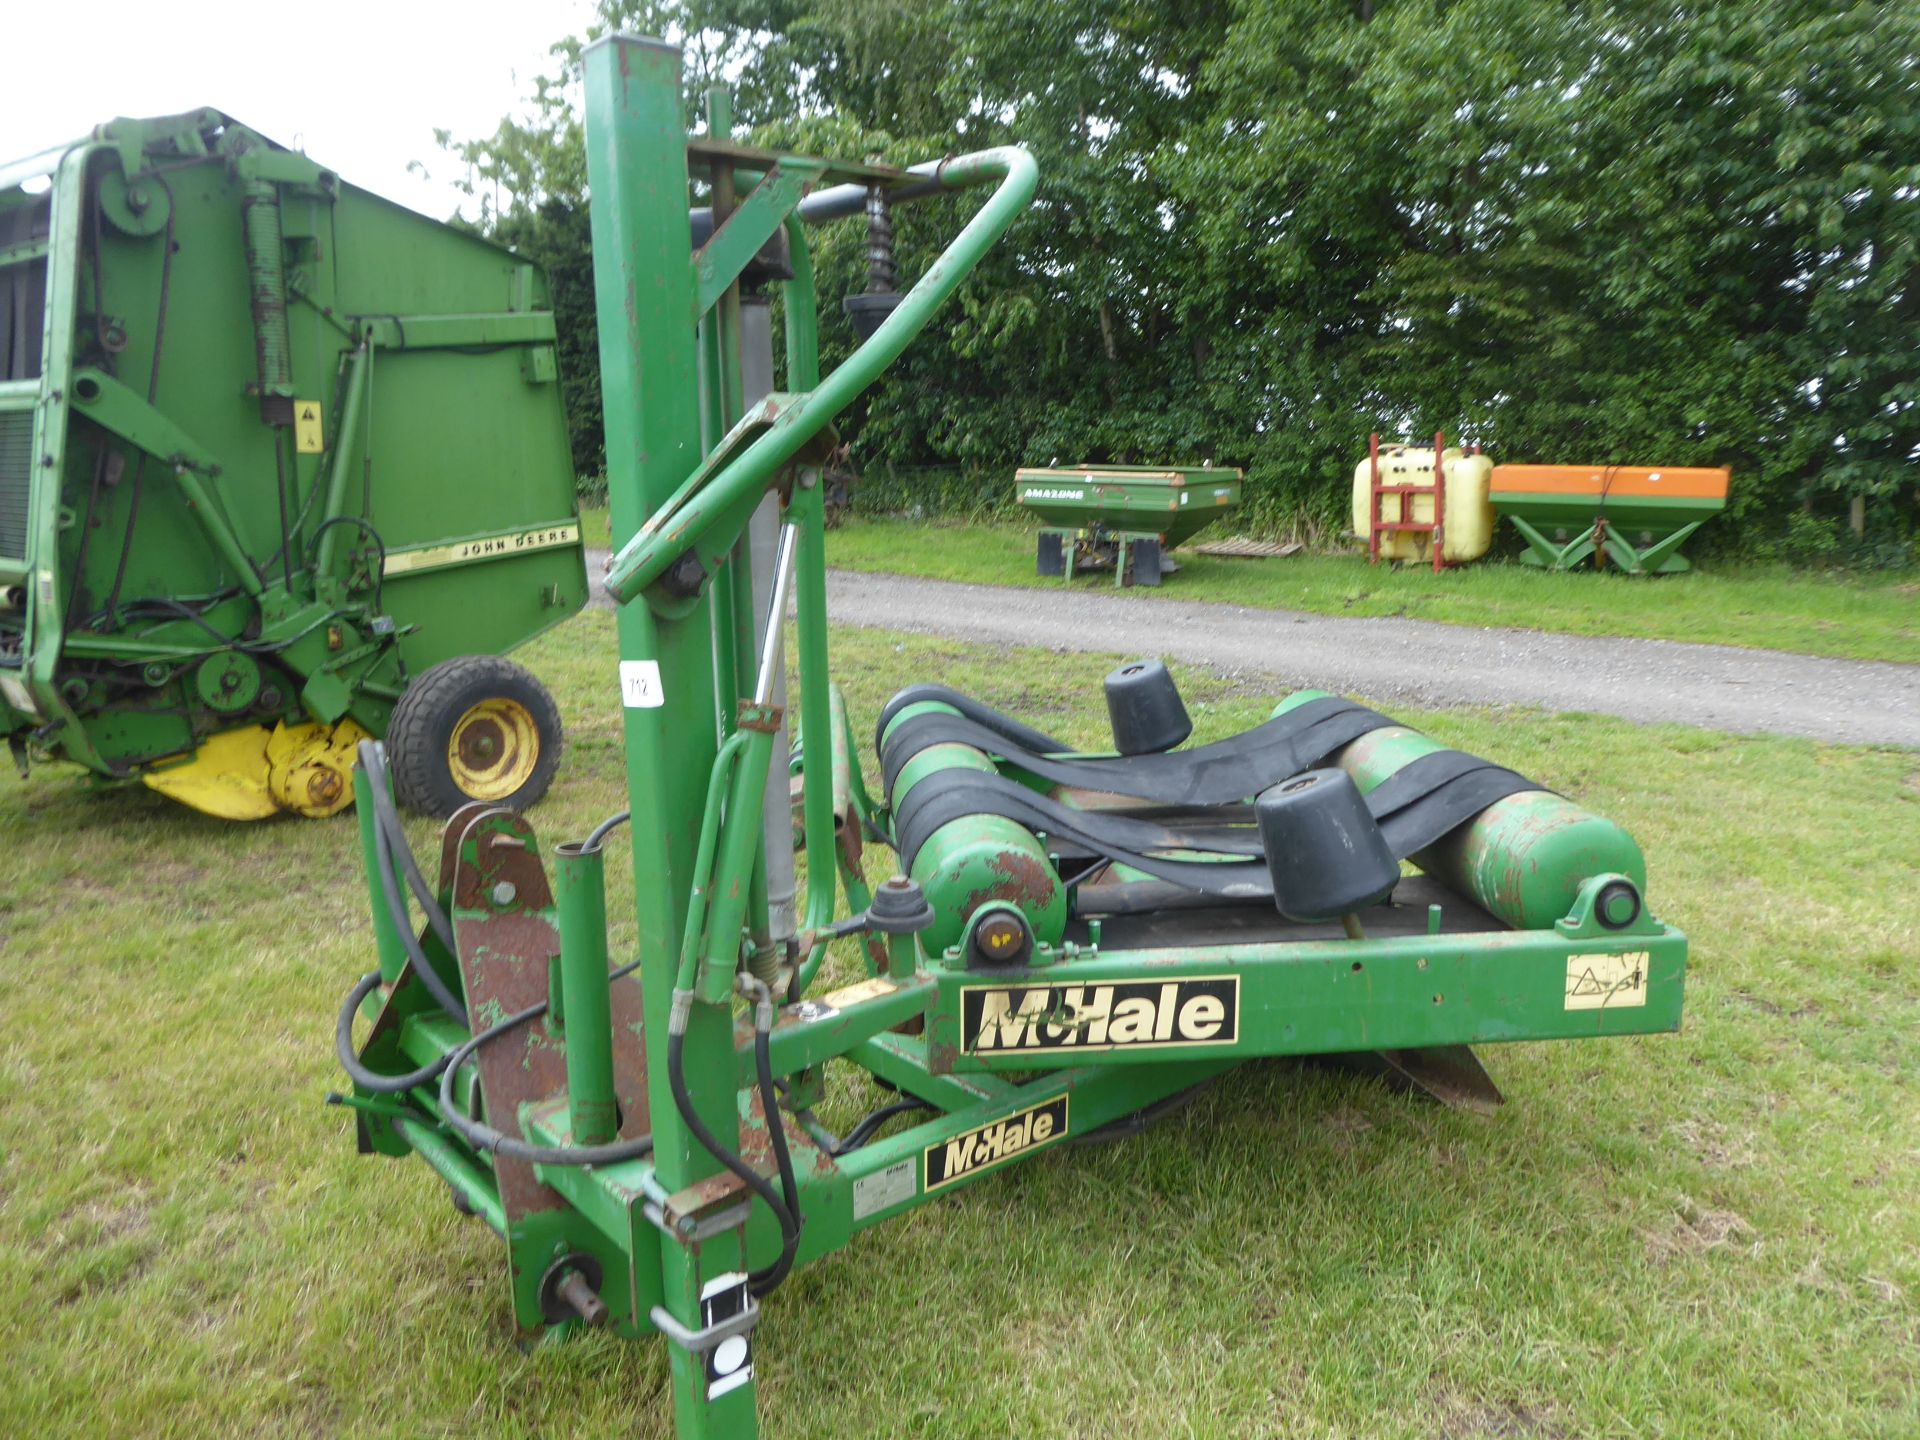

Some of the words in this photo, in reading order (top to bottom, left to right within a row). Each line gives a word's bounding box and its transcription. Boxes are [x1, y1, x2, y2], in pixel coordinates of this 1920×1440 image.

[462, 539, 505, 557] JOHN
[515, 528, 568, 548] DEERE
[976, 983, 1225, 1048] McHale
[943, 1111, 1053, 1180] McHale
